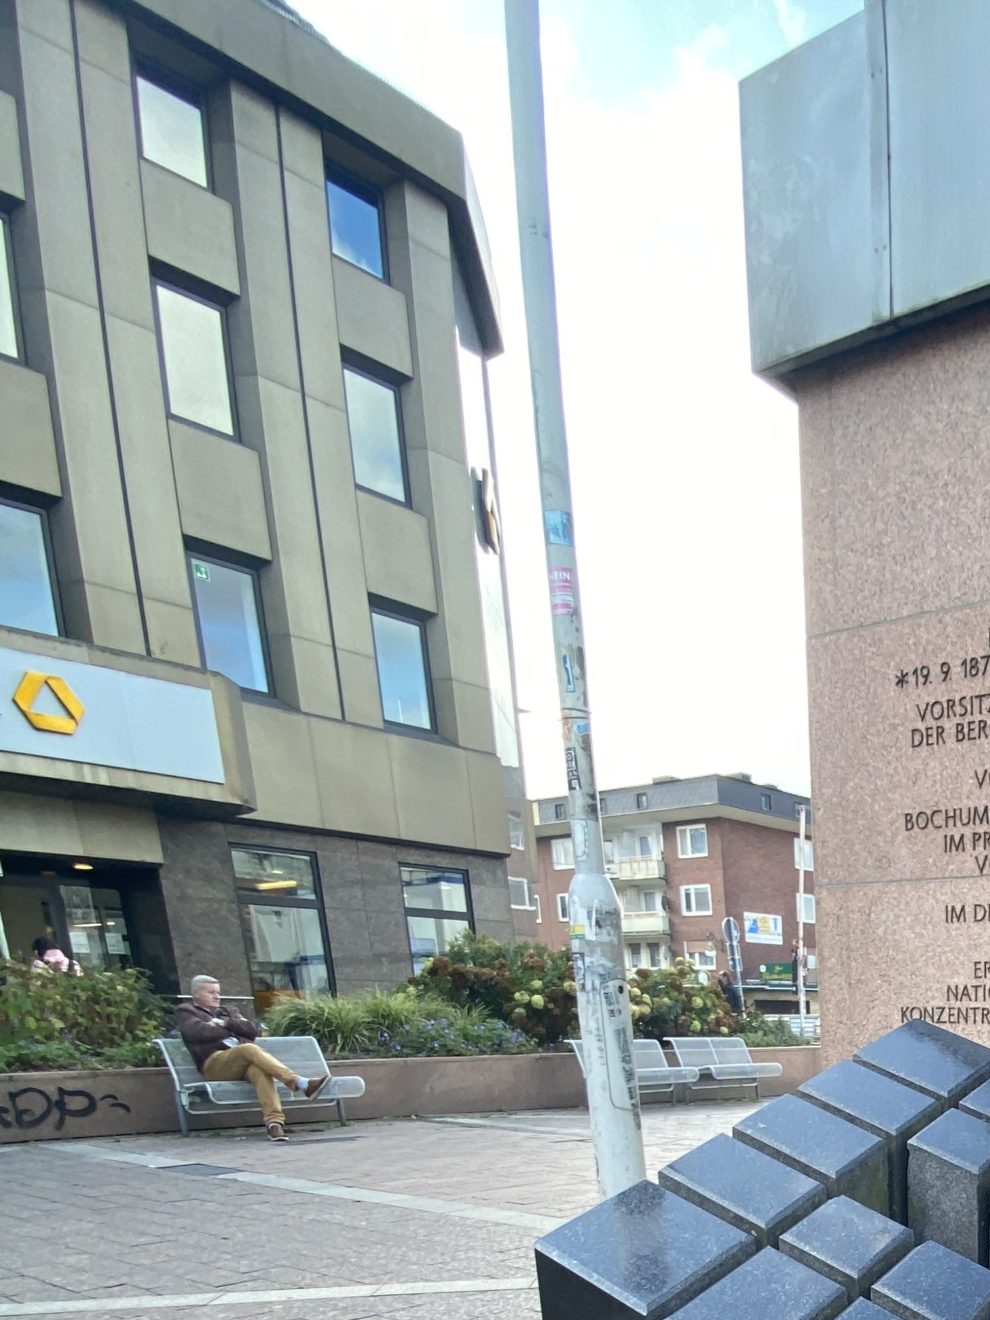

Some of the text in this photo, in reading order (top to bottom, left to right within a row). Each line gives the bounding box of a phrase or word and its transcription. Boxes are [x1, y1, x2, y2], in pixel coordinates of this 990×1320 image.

[911, 725, 946, 749] DER
[944, 833, 966, 853] IM
[945, 904, 967, 924] IM
